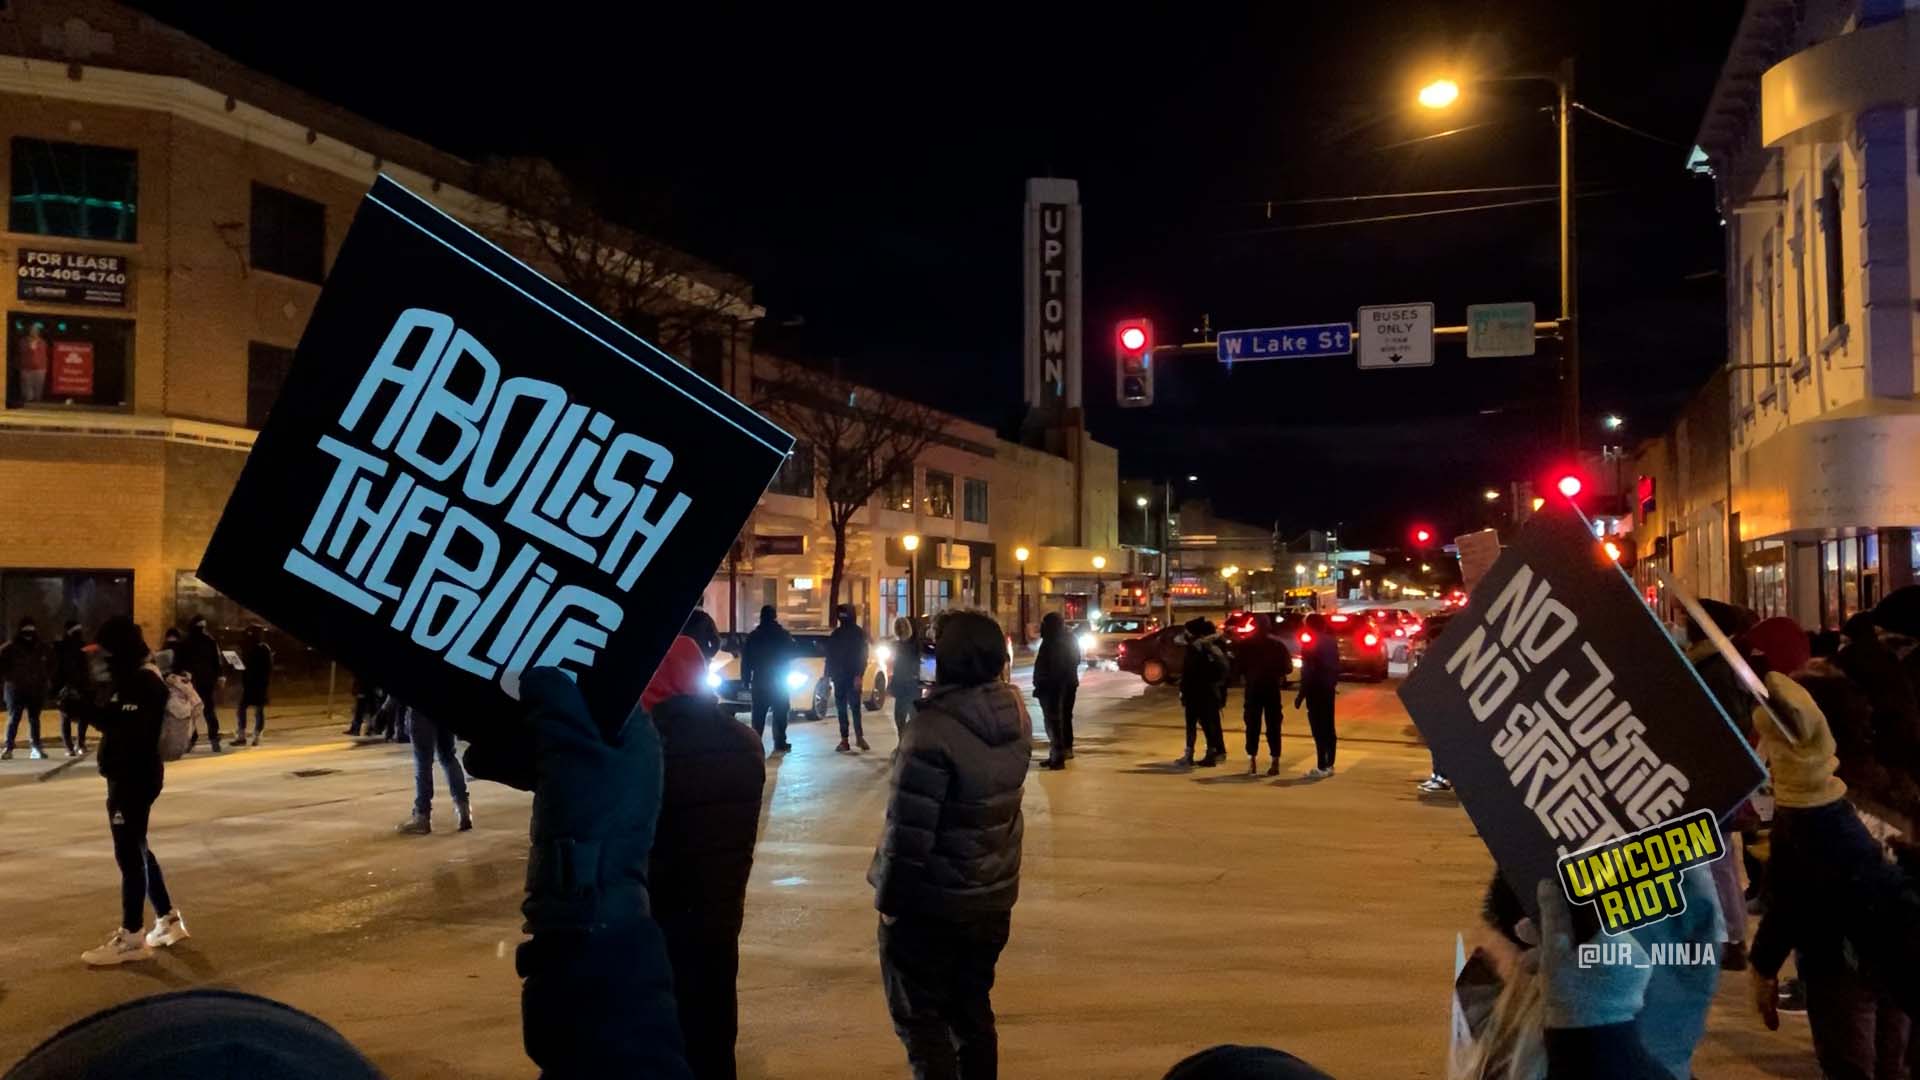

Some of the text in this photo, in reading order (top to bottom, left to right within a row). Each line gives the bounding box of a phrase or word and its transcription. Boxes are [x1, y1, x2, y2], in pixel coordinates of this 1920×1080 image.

[27, 252, 118, 270] FOR LEASE
[1044, 210, 1064, 383] UPTOWN
[1372, 309, 1418, 322] BUSES
[1225, 331, 1344, 354] W Lake St
[1377, 323, 1414, 335] ONLY
[317, 434, 449, 601] THE
[1485, 564, 1579, 664] NO
[1445, 624, 1519, 722] NO
